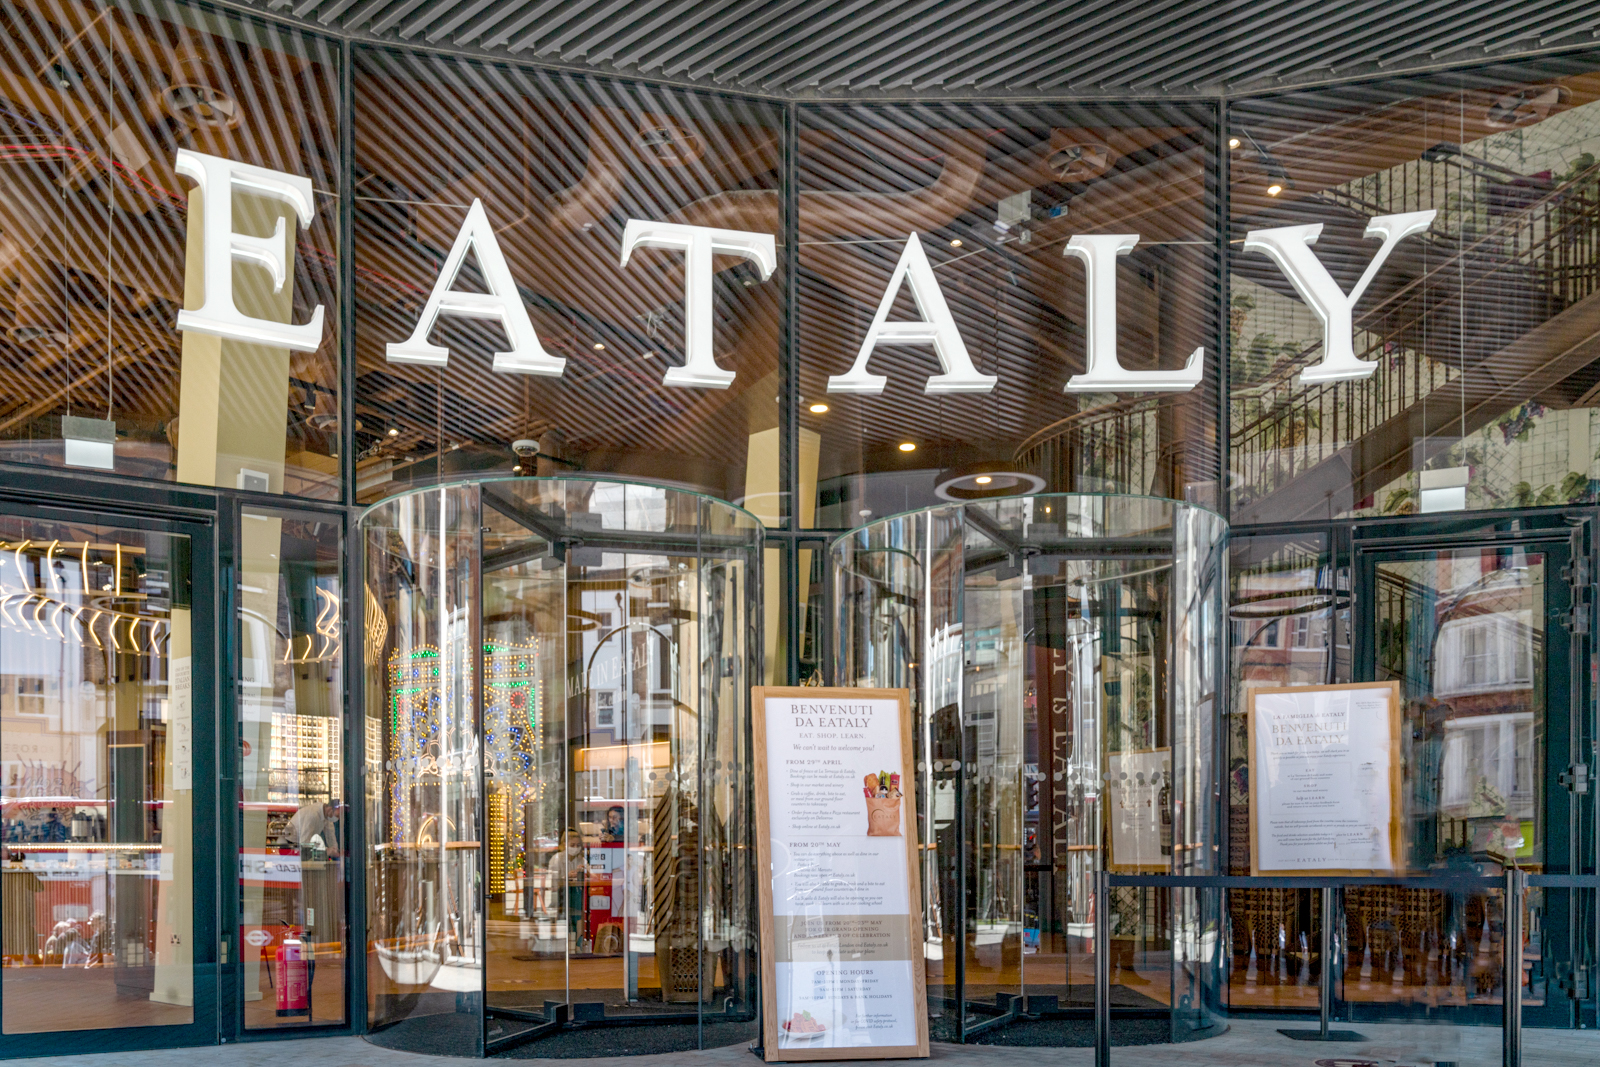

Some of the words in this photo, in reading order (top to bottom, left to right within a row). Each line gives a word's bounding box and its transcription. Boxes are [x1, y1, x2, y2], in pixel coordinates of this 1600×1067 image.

[175, 147, 1437, 394] EATALY
[596, 660, 608, 686] IN
[790, 704, 873, 715] BENVENUTI
[795, 717, 814, 728] DA
[819, 717, 871, 728] EATALY
[1272, 722, 1346, 734] BENVENUTI
[1276, 736, 1294, 746] DA
[1297, 734, 1344, 745] EATALY
